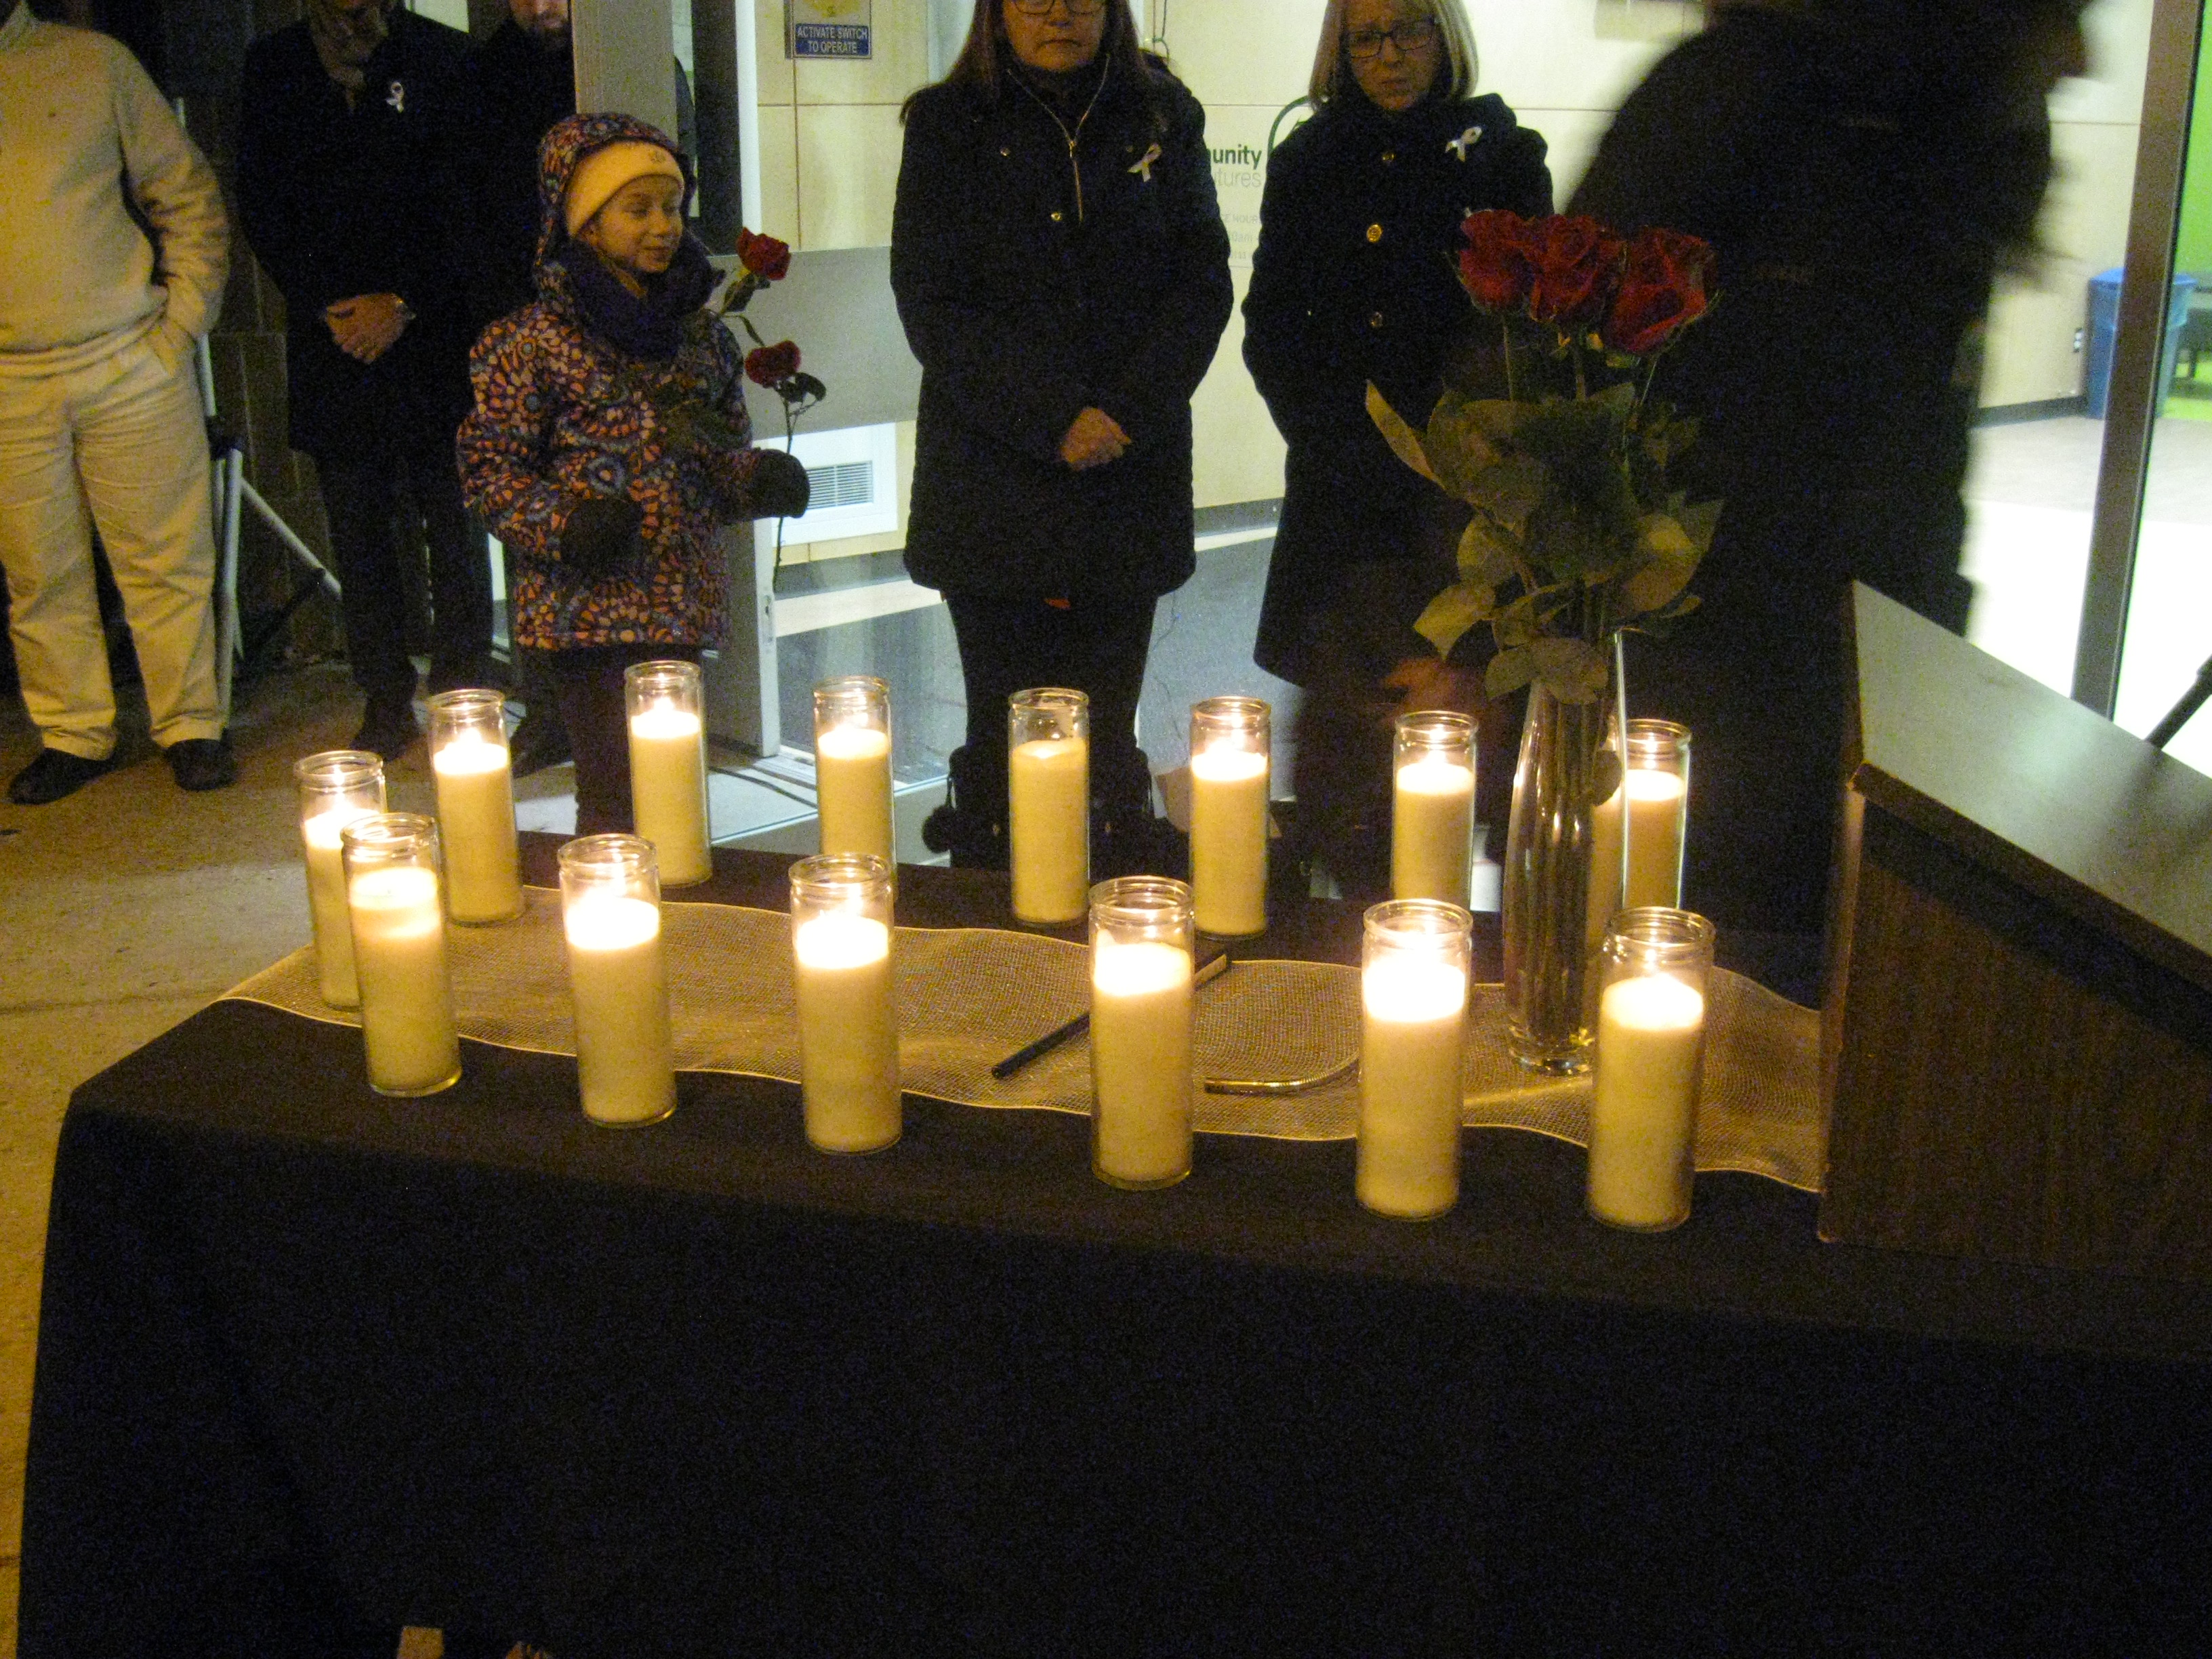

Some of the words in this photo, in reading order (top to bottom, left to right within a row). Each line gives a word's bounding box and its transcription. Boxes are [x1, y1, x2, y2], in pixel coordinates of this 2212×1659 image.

[797, 26, 835, 39] ACTIVATE
[837, 27, 868, 40] SWITCH
[807, 41, 819, 53] TO
[820, 41, 857, 54] OPERATE
[1208, 144, 1263, 170] unity
[1214, 166, 1262, 188] tures
[1232, 214, 1258, 224] HOUR
